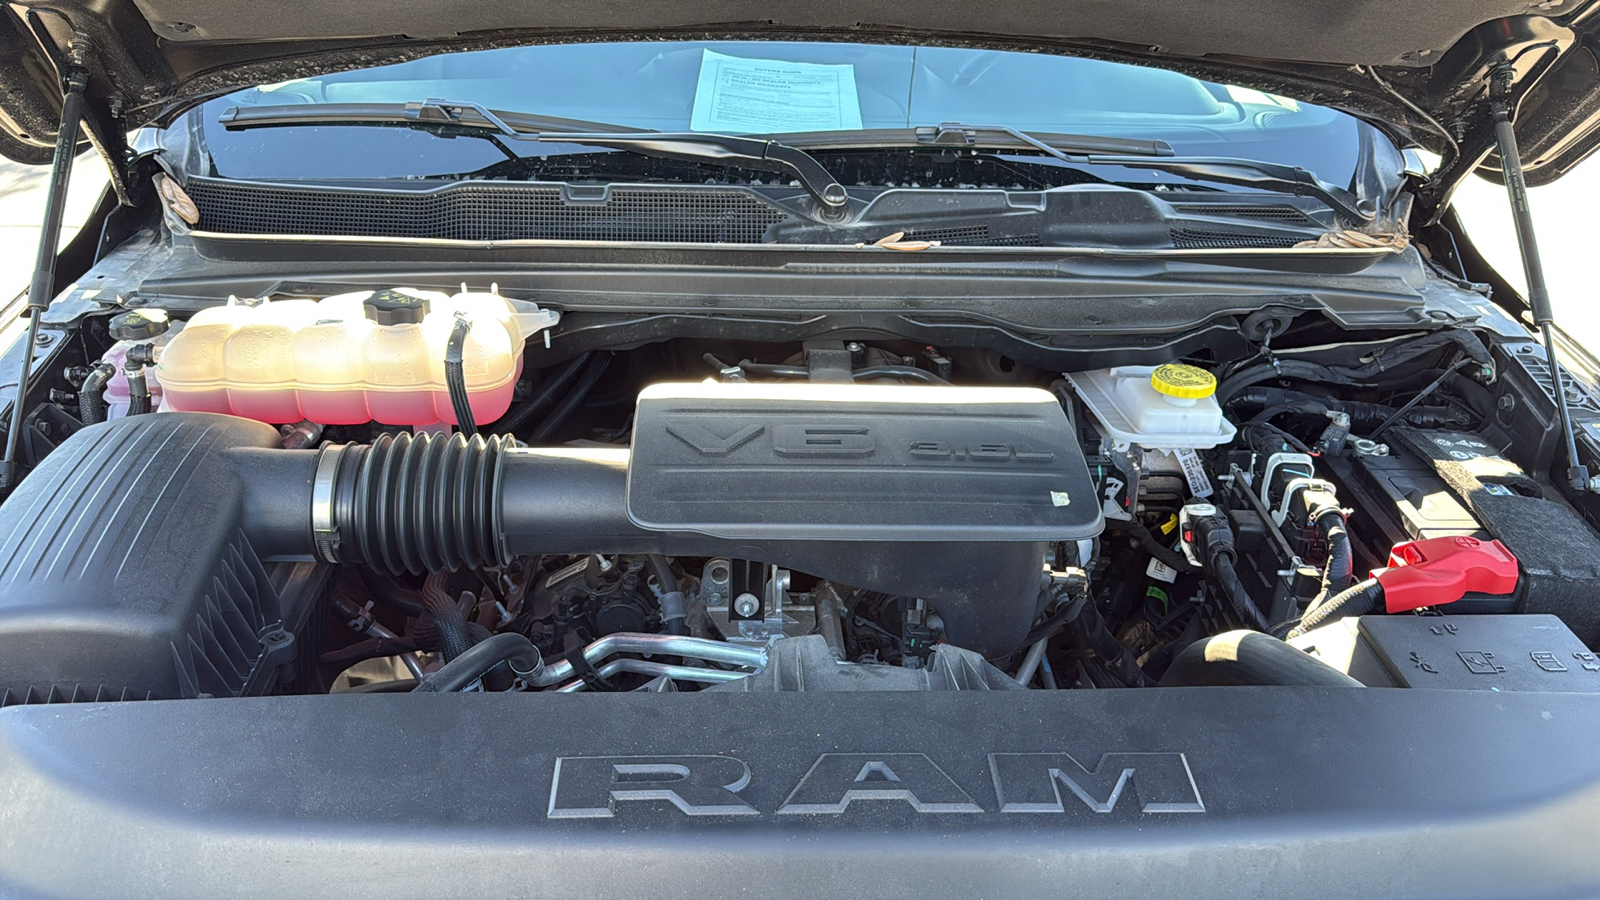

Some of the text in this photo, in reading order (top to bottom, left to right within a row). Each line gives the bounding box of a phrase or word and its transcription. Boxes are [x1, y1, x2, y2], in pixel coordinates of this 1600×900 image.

[665, 422, 1055, 461] V6 3.6L
[547, 752, 1206, 818] RAM
